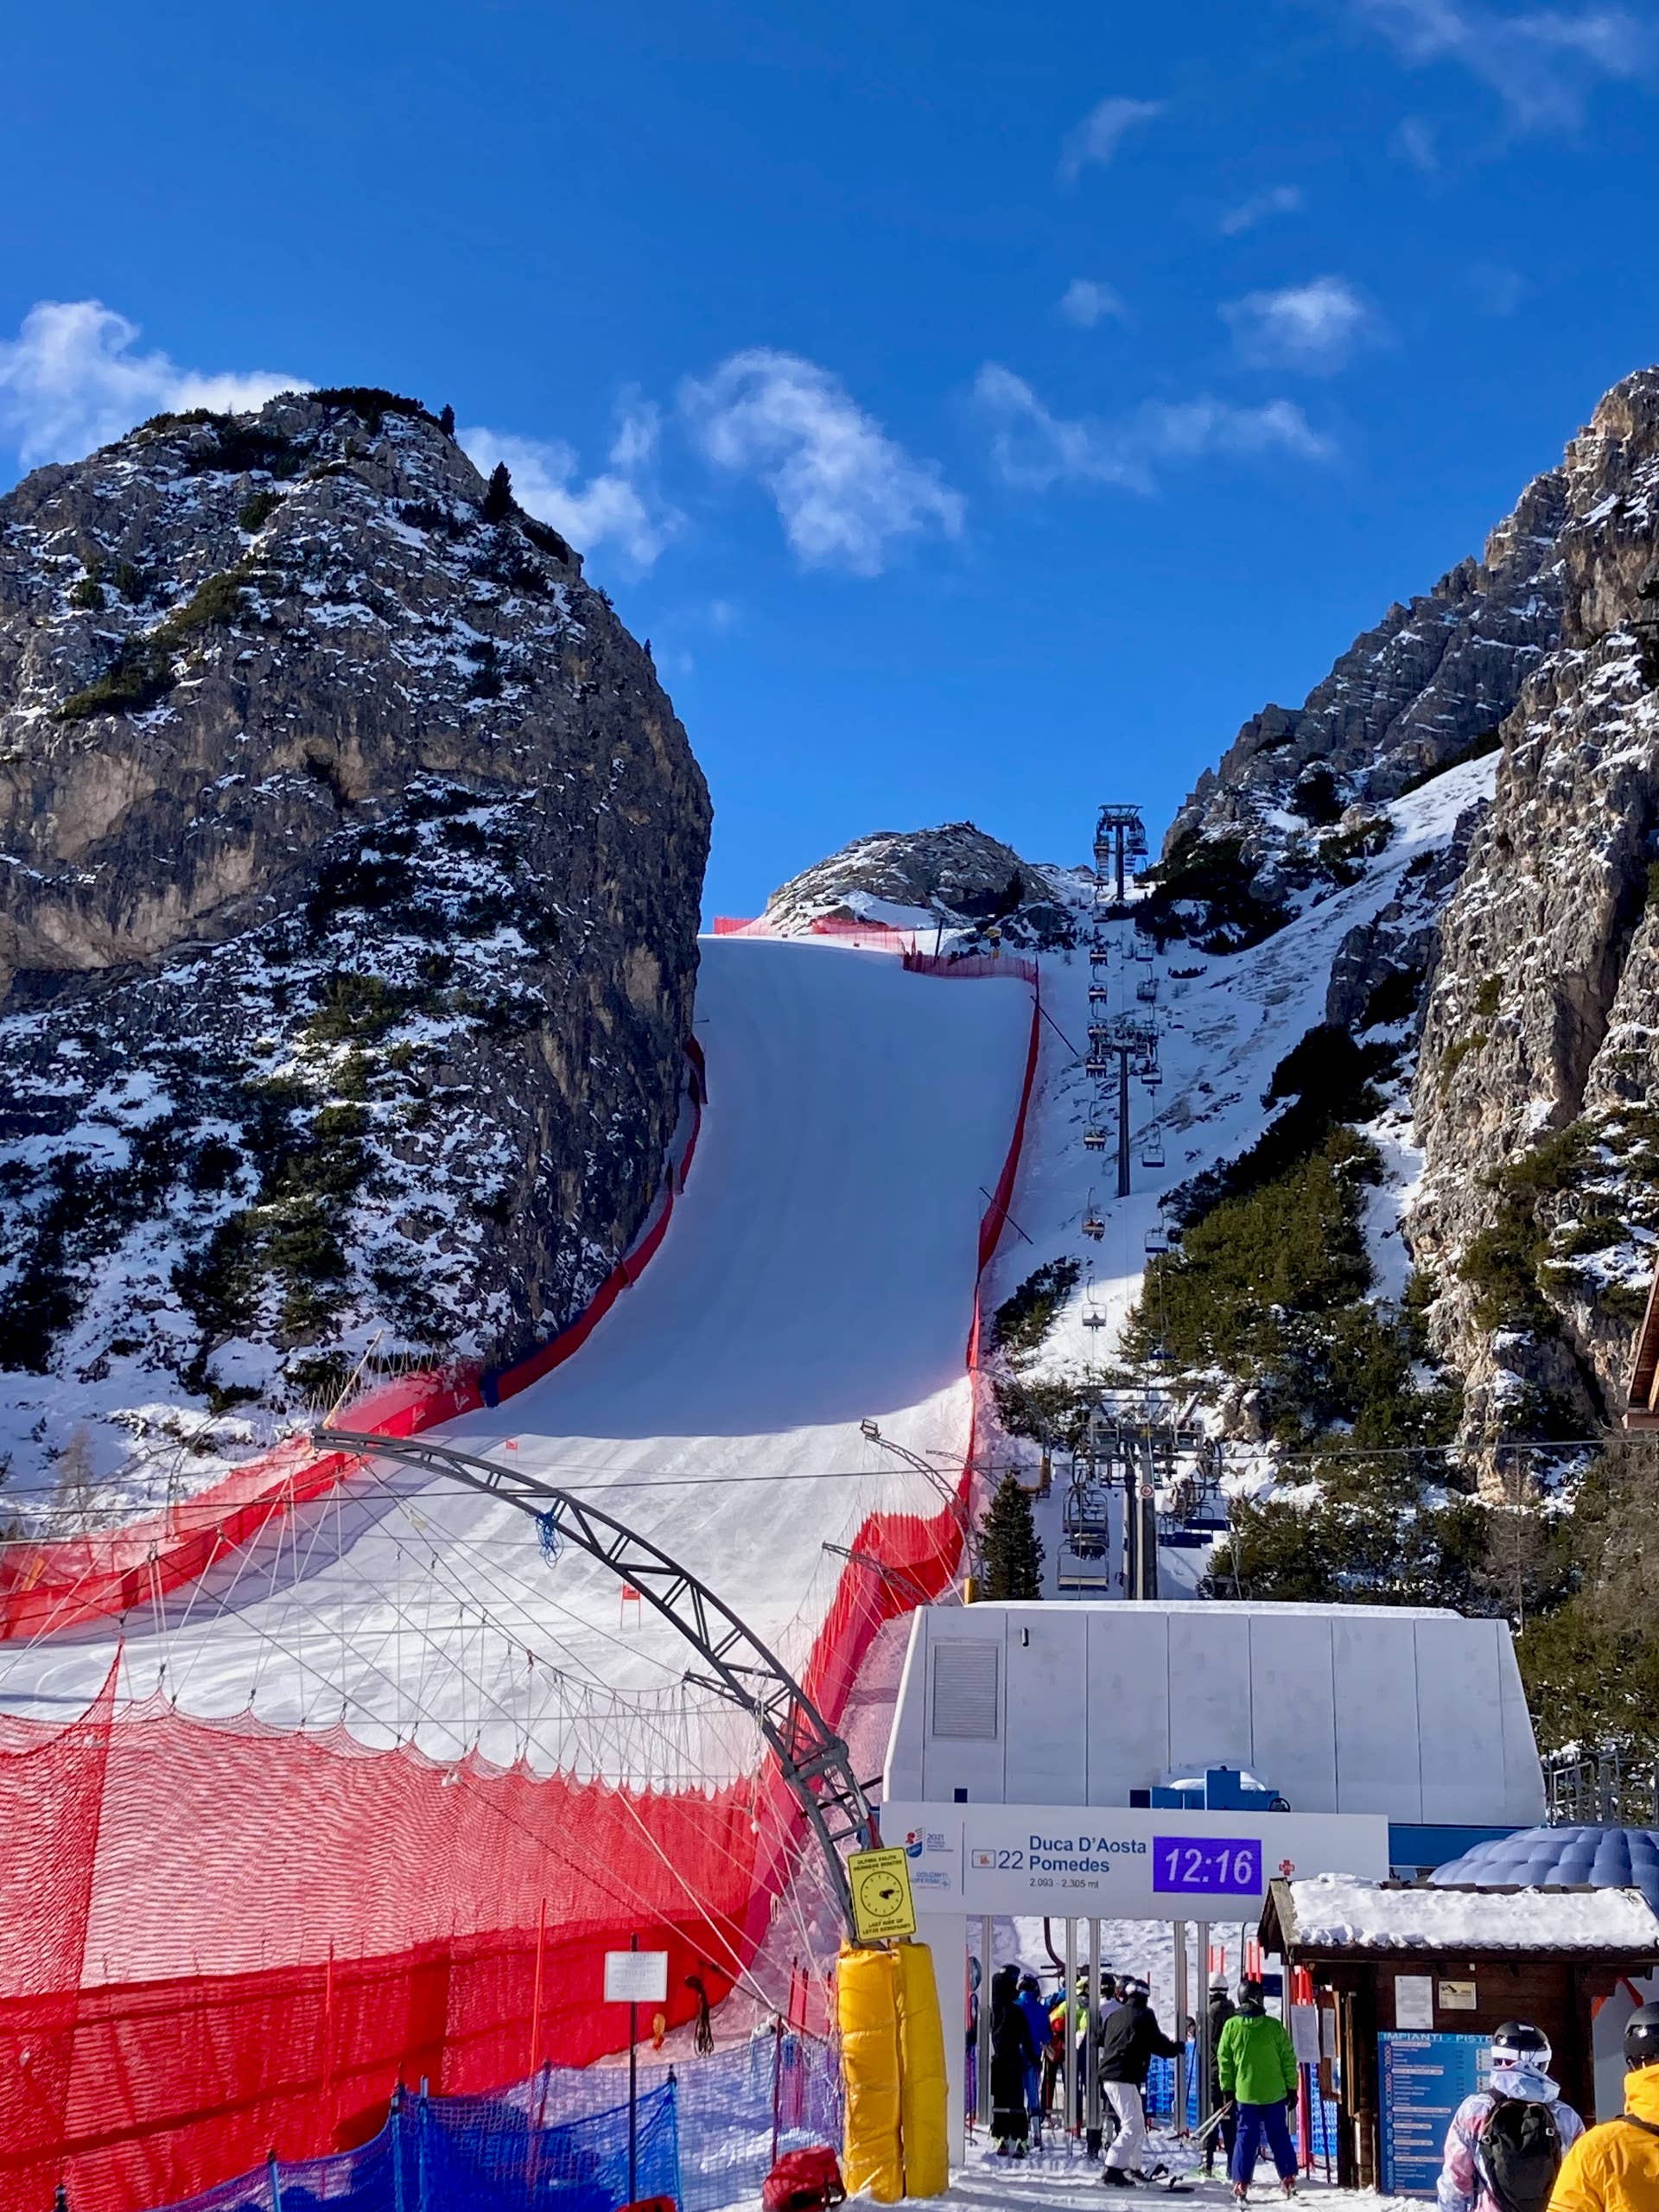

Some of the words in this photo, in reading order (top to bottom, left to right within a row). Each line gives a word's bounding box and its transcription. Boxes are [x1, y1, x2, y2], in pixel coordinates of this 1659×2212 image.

[1029, 1835, 1073, 1852] Duca
[1079, 1837, 1147, 1853] D’Aosta
[998, 1850, 1024, 1870] 22
[1029, 1855, 1110, 1872] Pomedes
[1166, 1848, 1253, 1885] 12:16
[1029, 1878, 1054, 1888] 2.093
[1061, 1878, 1086, 1889] 2.305
[1383, 2032, 1442, 2042] IMPIANTI
